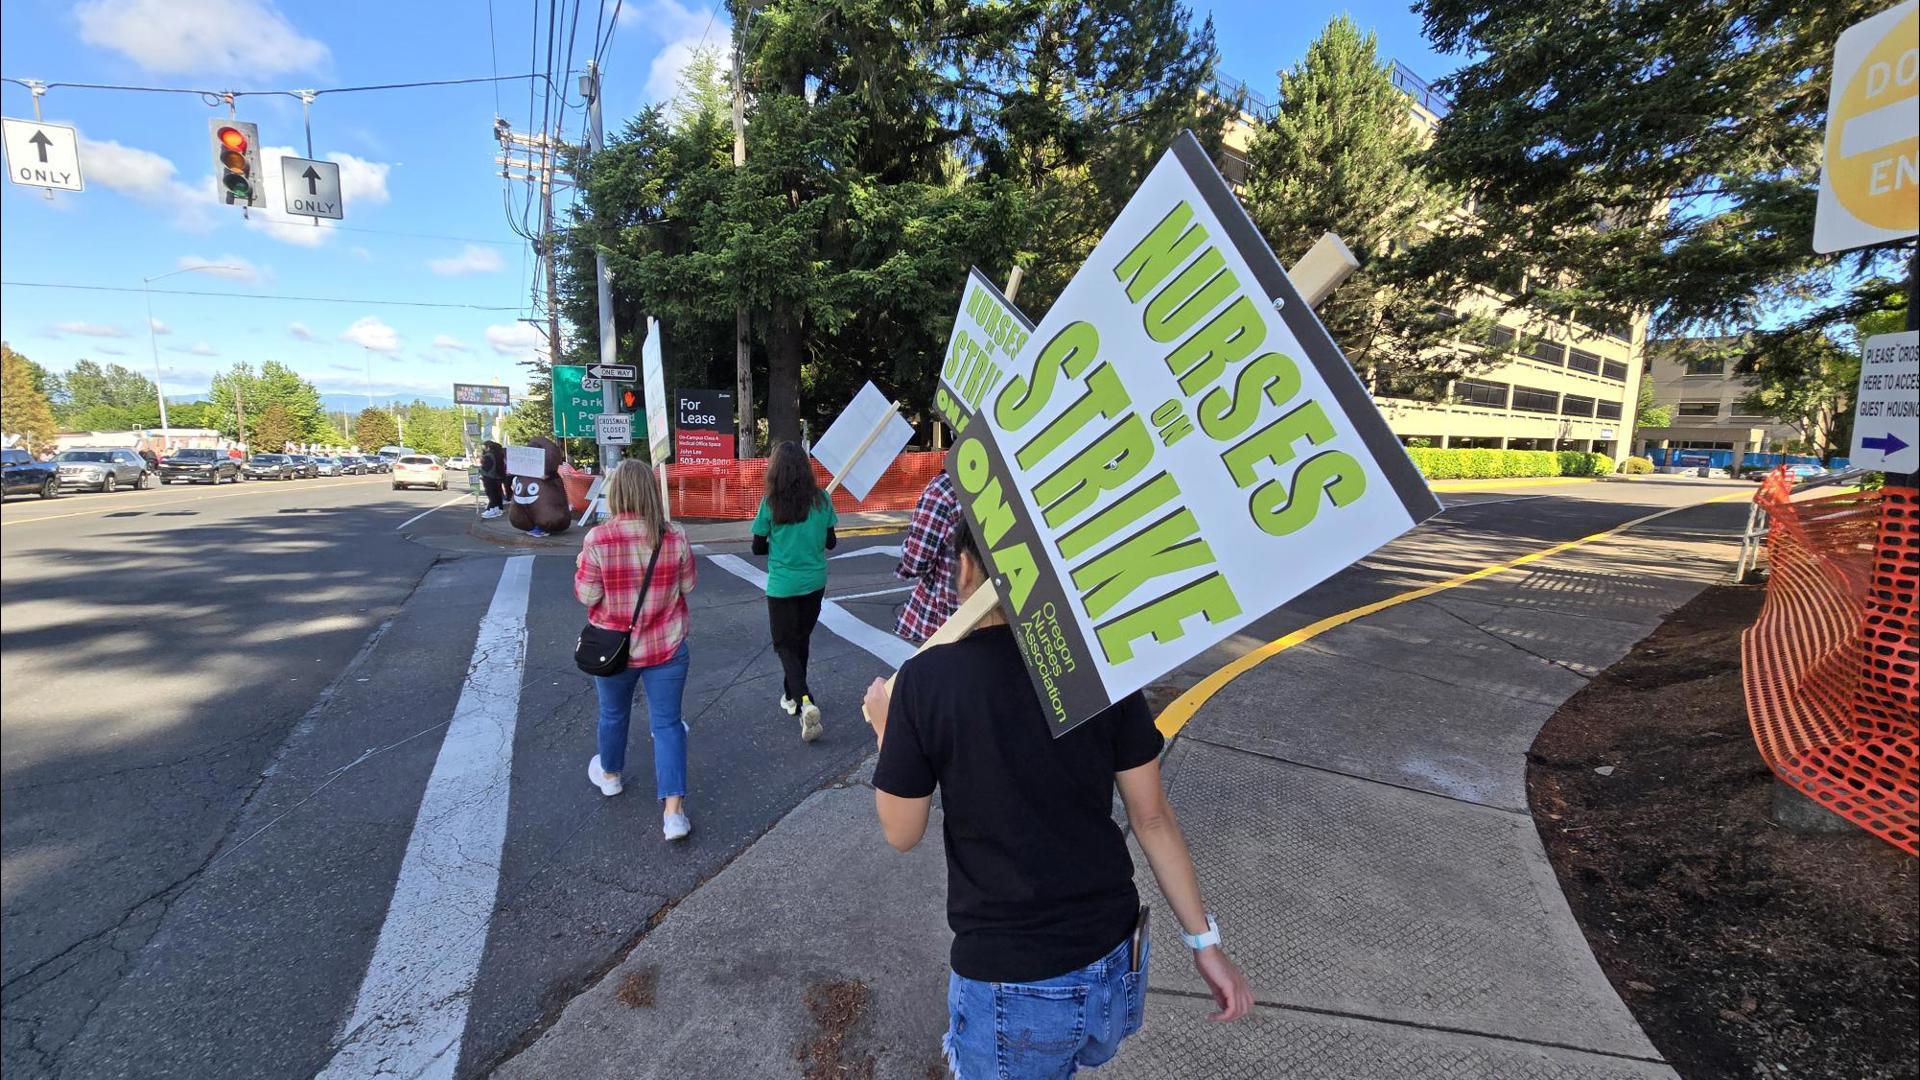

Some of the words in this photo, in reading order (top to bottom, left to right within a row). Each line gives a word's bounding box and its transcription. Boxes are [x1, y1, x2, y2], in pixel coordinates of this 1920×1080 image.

[1866, 48, 1919, 99] DO
[20, 167, 71, 184] ONLY
[1870, 150, 1919, 195] EN
[294, 199, 335, 214] ONLY
[966, 285, 1029, 361] NURSES
[945, 330, 1003, 411] STRI
[1113, 200, 1366, 536] NURSES
[1866, 347, 1896, 364] PLEASE
[1899, 345, 1919, 363] CROS
[584, 379, 600, 389] 26
[681, 398, 701, 410] For
[1864, 375, 1883, 390] HERE
[1884, 374, 1893, 390] TO
[1895, 373, 1919, 390] ACCES
[681, 411, 716, 424] Lease
[1151, 399, 1194, 447] ON
[1860, 401, 1884, 416] GUEST
[994, 321, 1242, 666] STRIKE
[957, 438, 1040, 616] ONA
[1031, 610, 1062, 677] Nurses
[1043, 602, 1076, 673] Oregon
[1021, 622, 1067, 722] Association
